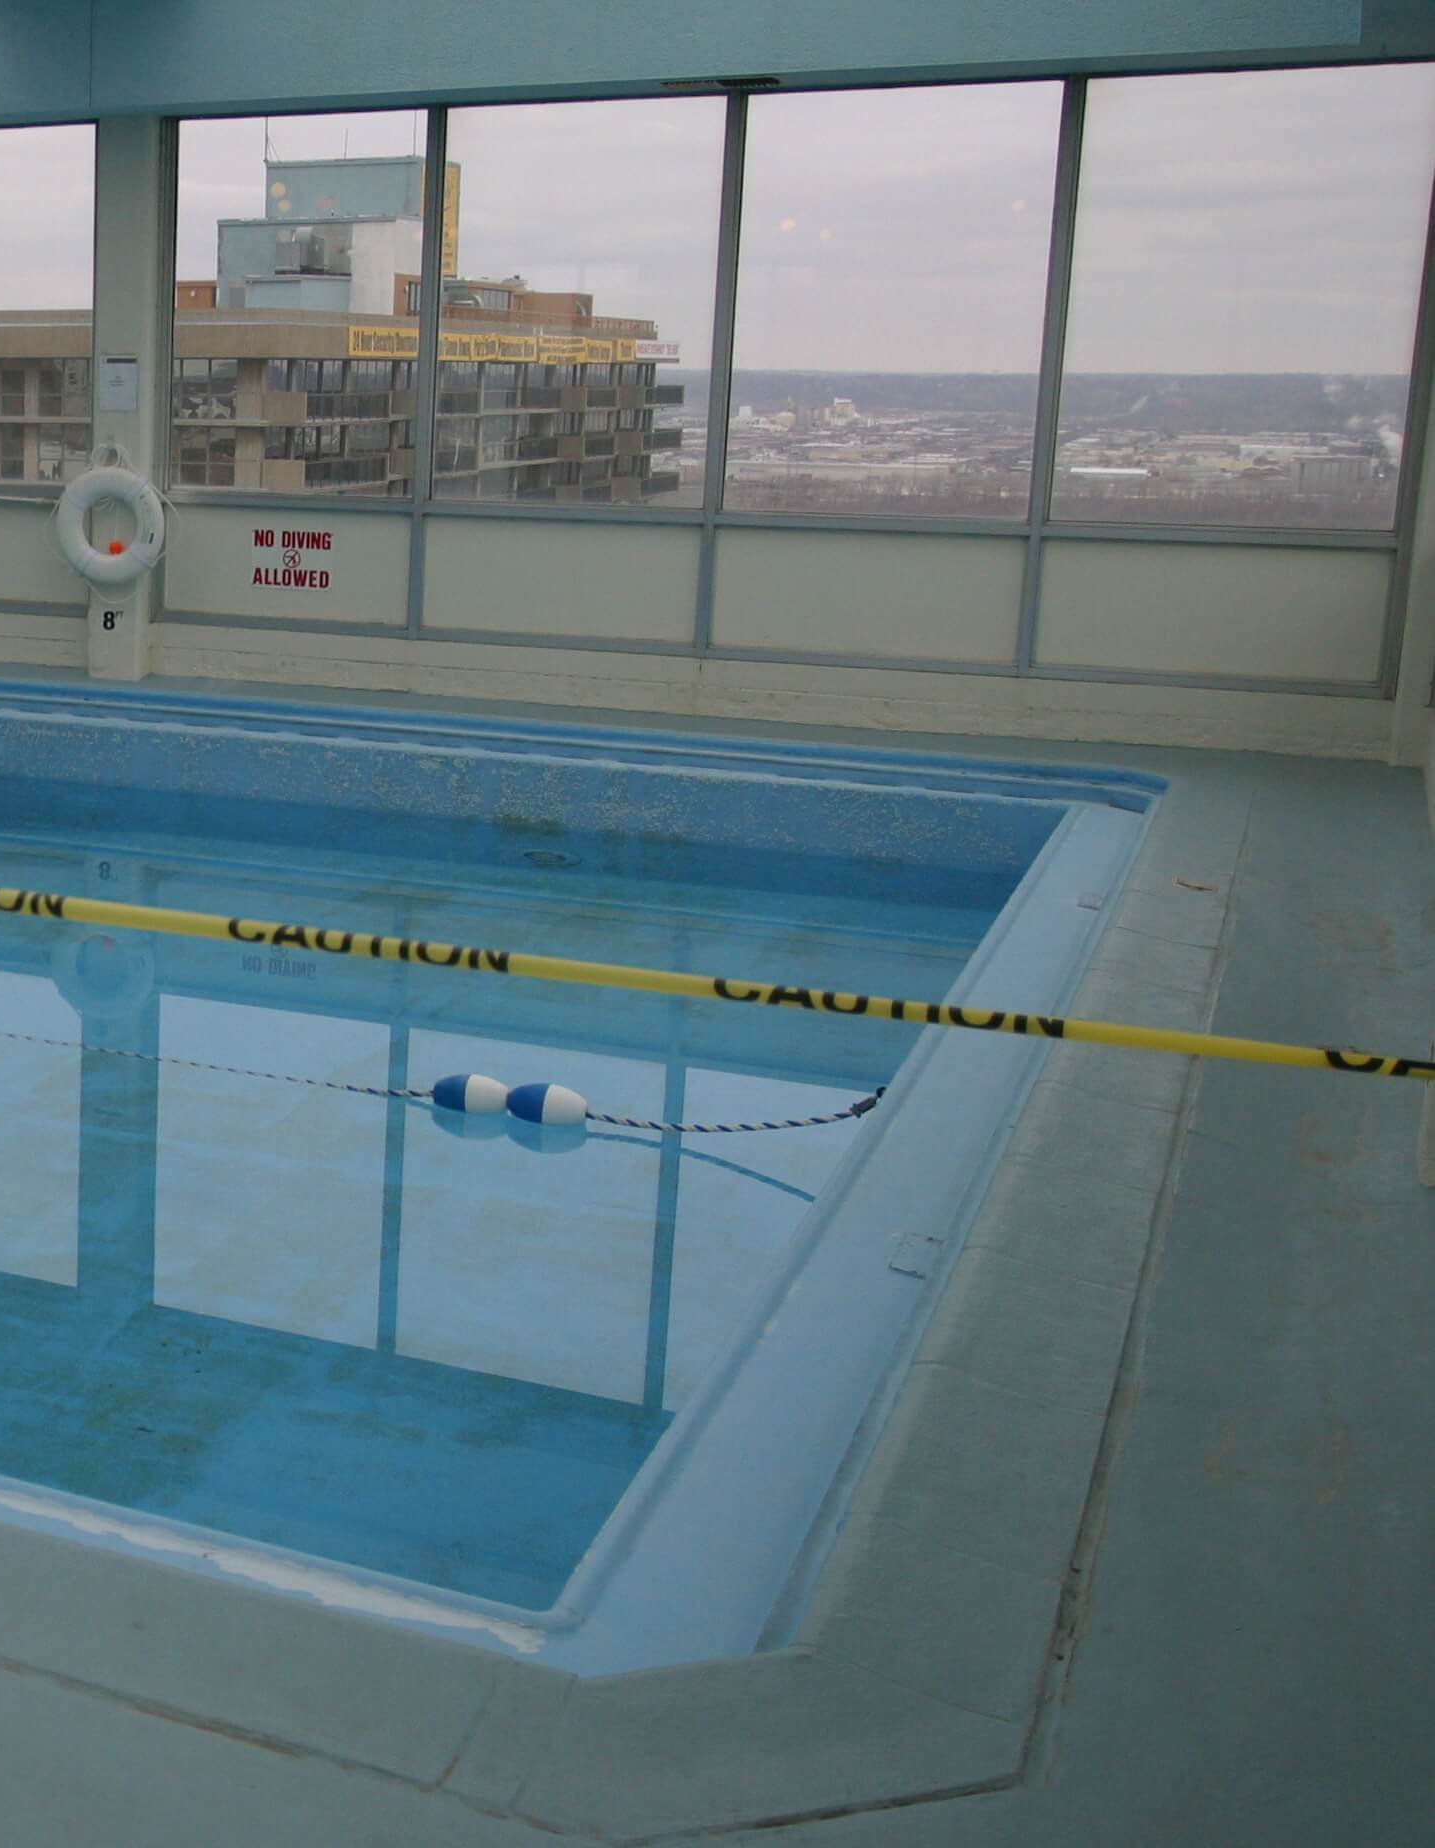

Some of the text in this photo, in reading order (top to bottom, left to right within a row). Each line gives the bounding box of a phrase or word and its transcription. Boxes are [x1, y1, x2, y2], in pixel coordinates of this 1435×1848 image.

[253, 529, 331, 550] NO DIVING
[252, 567, 329, 588] ALLOWED
[103, 610, 115, 630] 8
[227, 916, 510, 974] CAUTION
[712, 977, 1065, 1039] CAUTION
